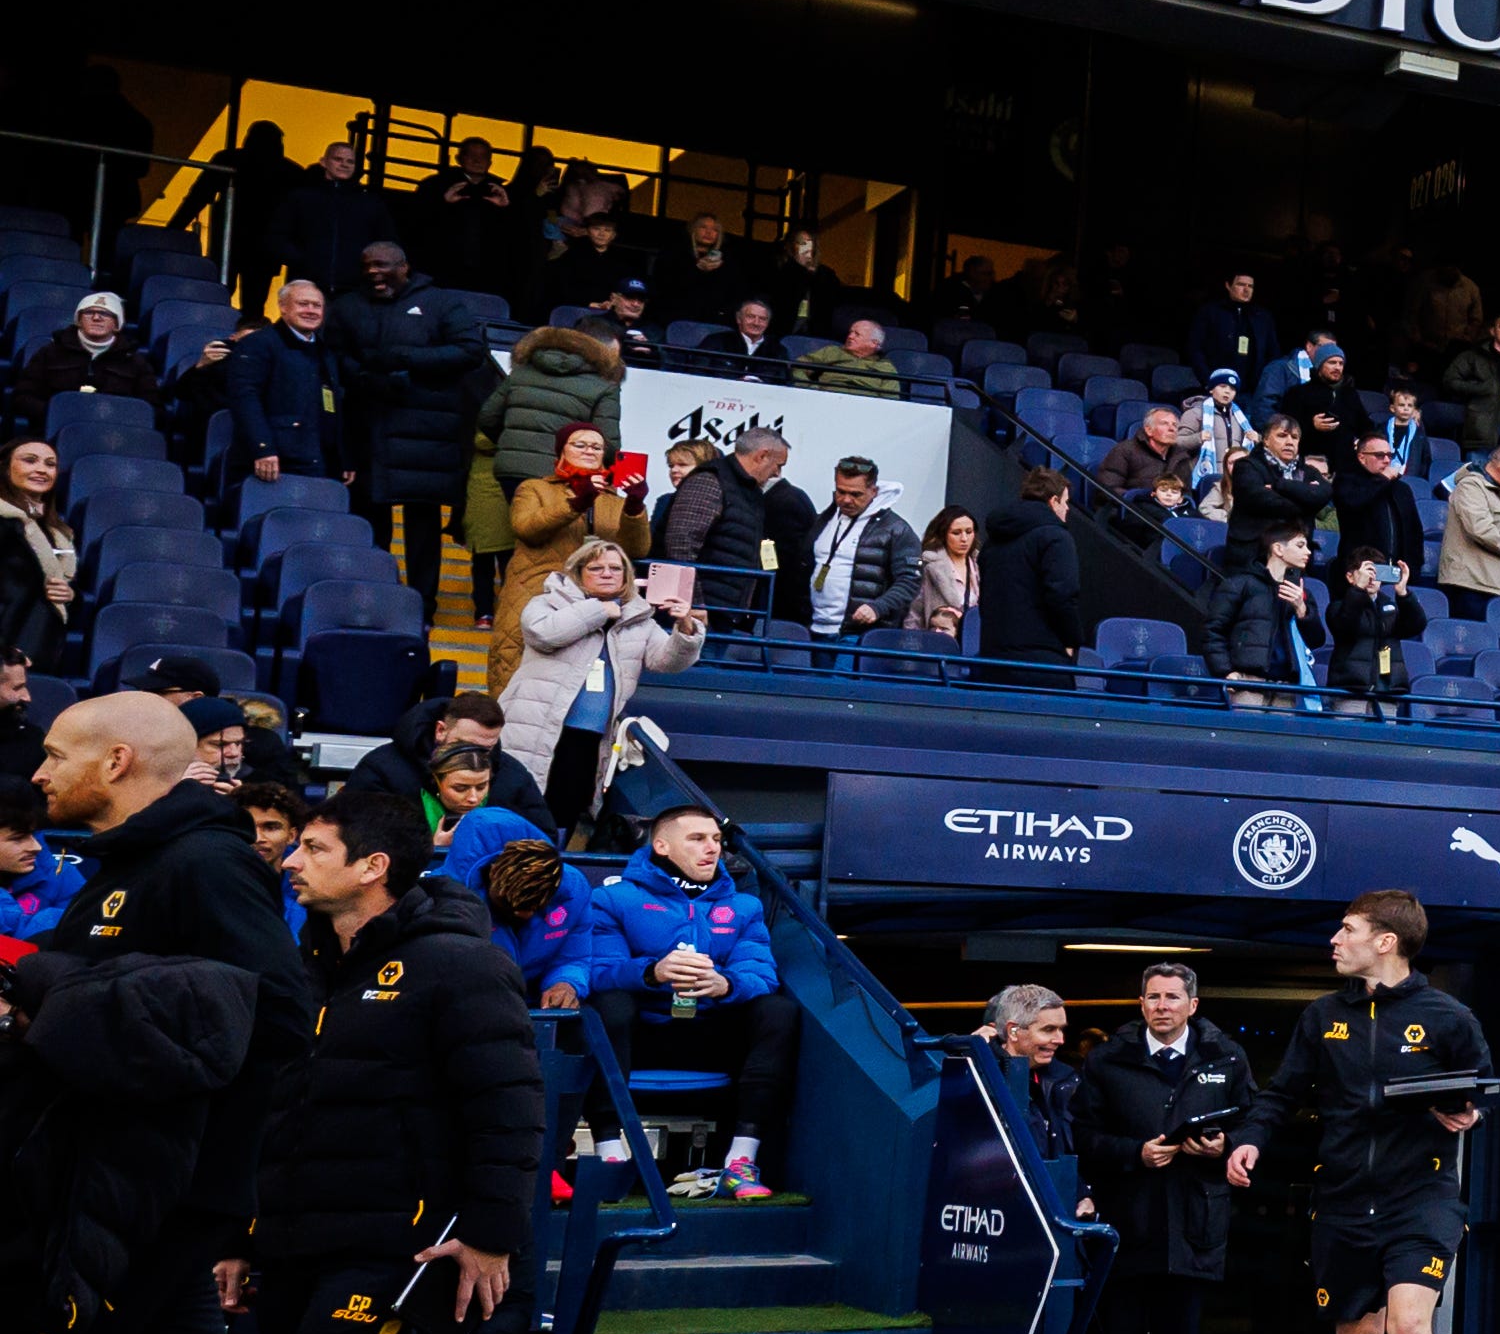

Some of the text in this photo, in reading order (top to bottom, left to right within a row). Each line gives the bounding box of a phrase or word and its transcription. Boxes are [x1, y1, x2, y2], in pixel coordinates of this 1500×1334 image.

[944, 808, 1133, 841] ETIHAD
[1244, 817, 1308, 843] MANCHESTER
[985, 842, 1092, 863] AIRWAYS
[1261, 875, 1286, 883] CITY
[941, 1204, 1005, 1236] ETIHAD
[951, 1243, 989, 1263] AIRWAYS
[348, 1294, 372, 1312] CP
